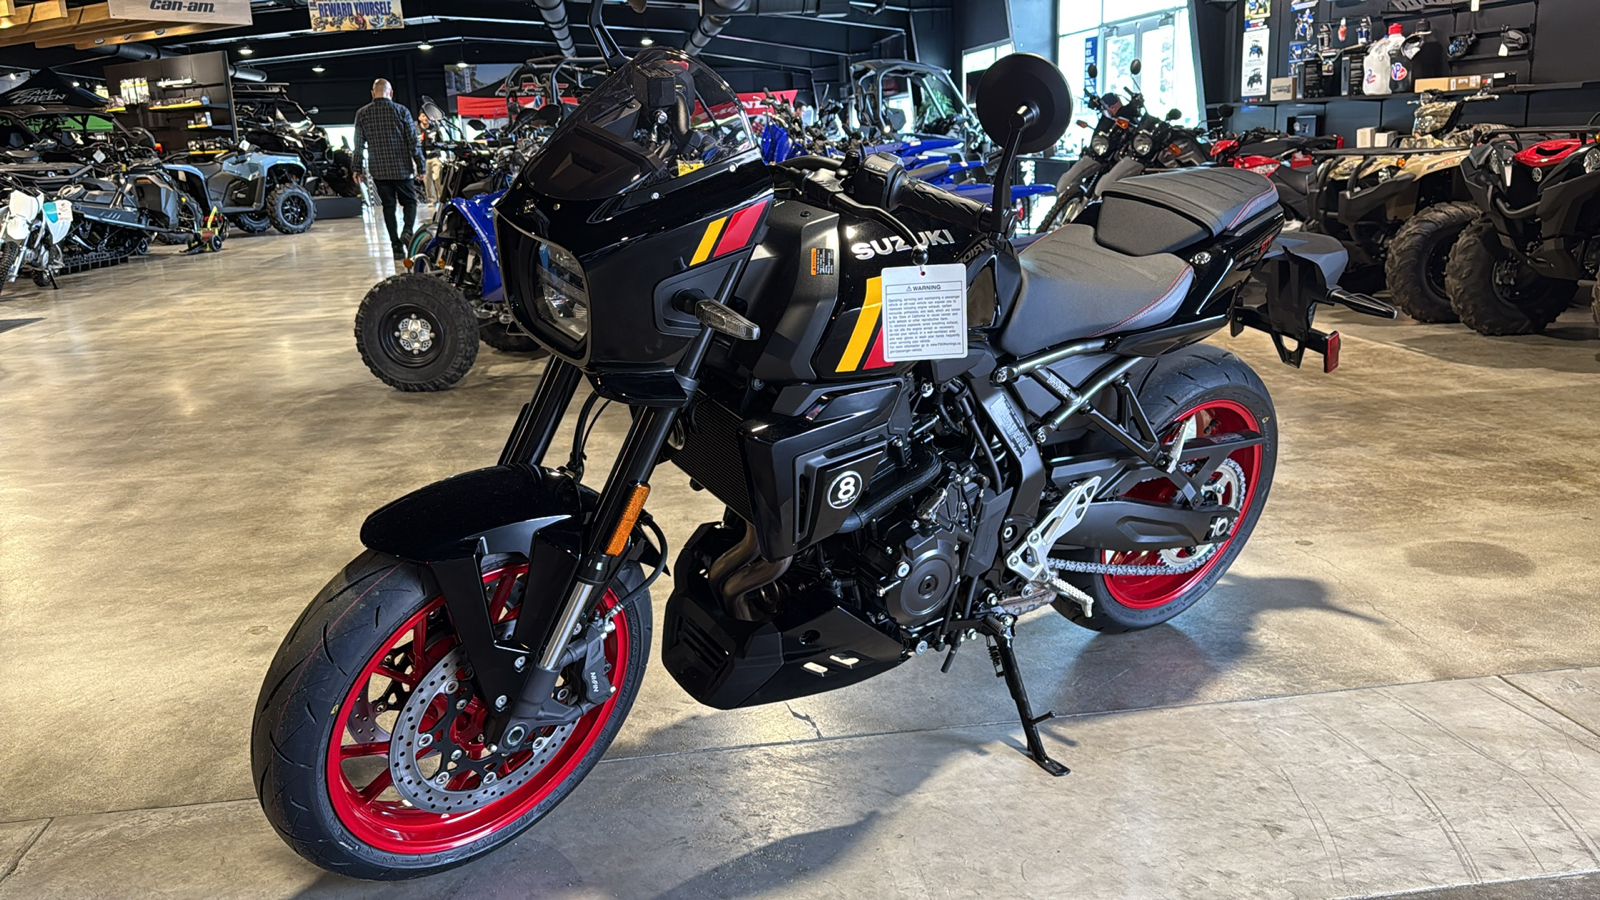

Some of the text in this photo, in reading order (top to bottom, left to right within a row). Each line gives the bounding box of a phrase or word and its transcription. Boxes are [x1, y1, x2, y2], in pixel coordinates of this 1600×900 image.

[318, 2, 352, 17] REWARD
[354, 1, 392, 16] YOURSELF
[12, 94, 66, 105] GREEN
[851, 229, 956, 260] SUZUKI
[838, 476, 855, 499] 8
